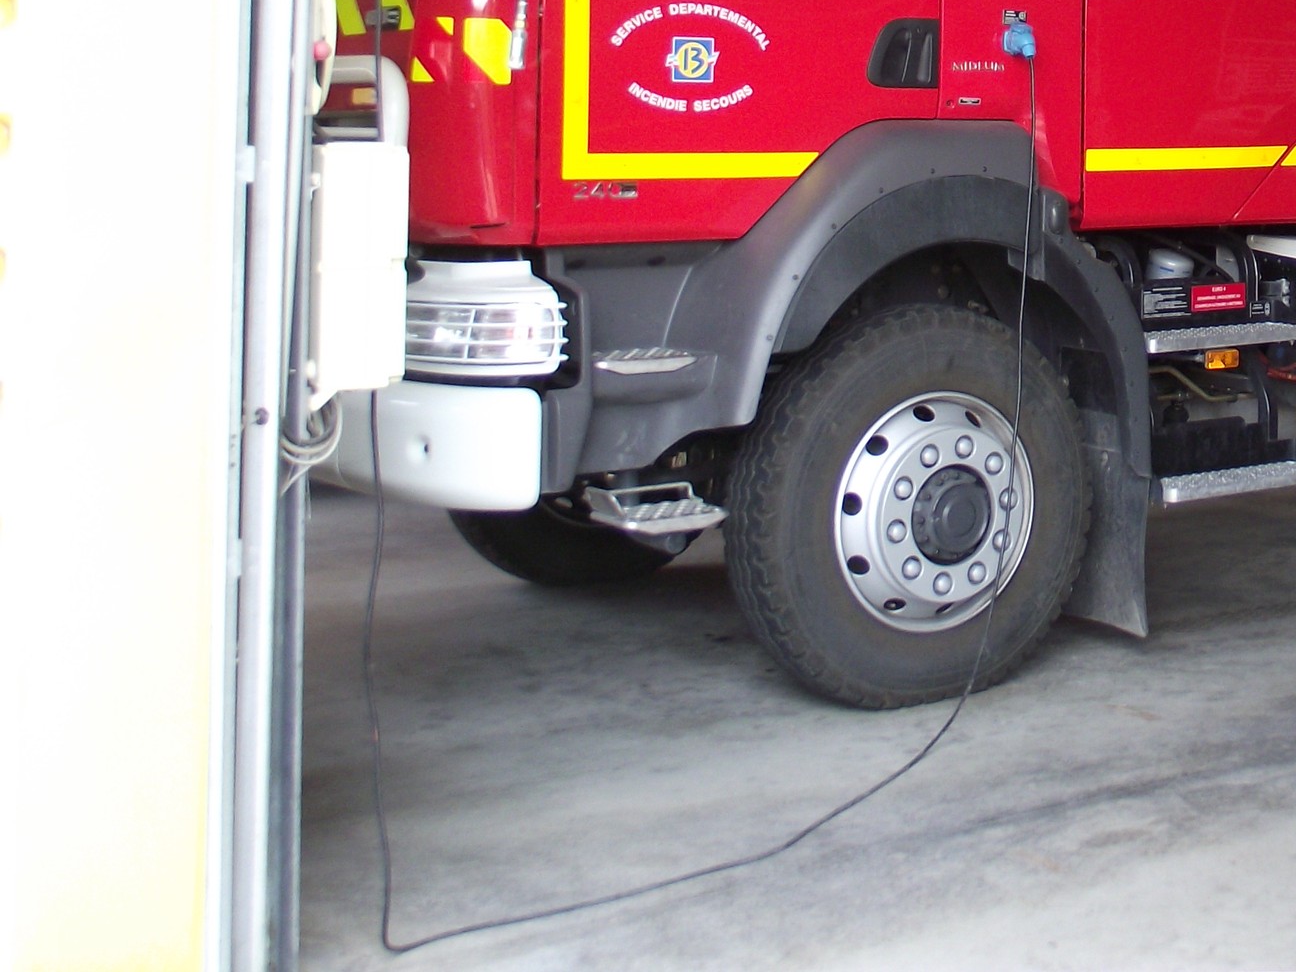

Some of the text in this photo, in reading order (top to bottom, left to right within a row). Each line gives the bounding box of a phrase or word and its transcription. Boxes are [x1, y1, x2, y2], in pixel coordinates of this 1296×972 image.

[610, 3, 771, 51] SERVICE DEPARTEMENTAL
[682, 46, 705, 75] 13
[628, 82, 754, 112] INCENDIE SECOURS
[573, 181, 622, 198] 240
